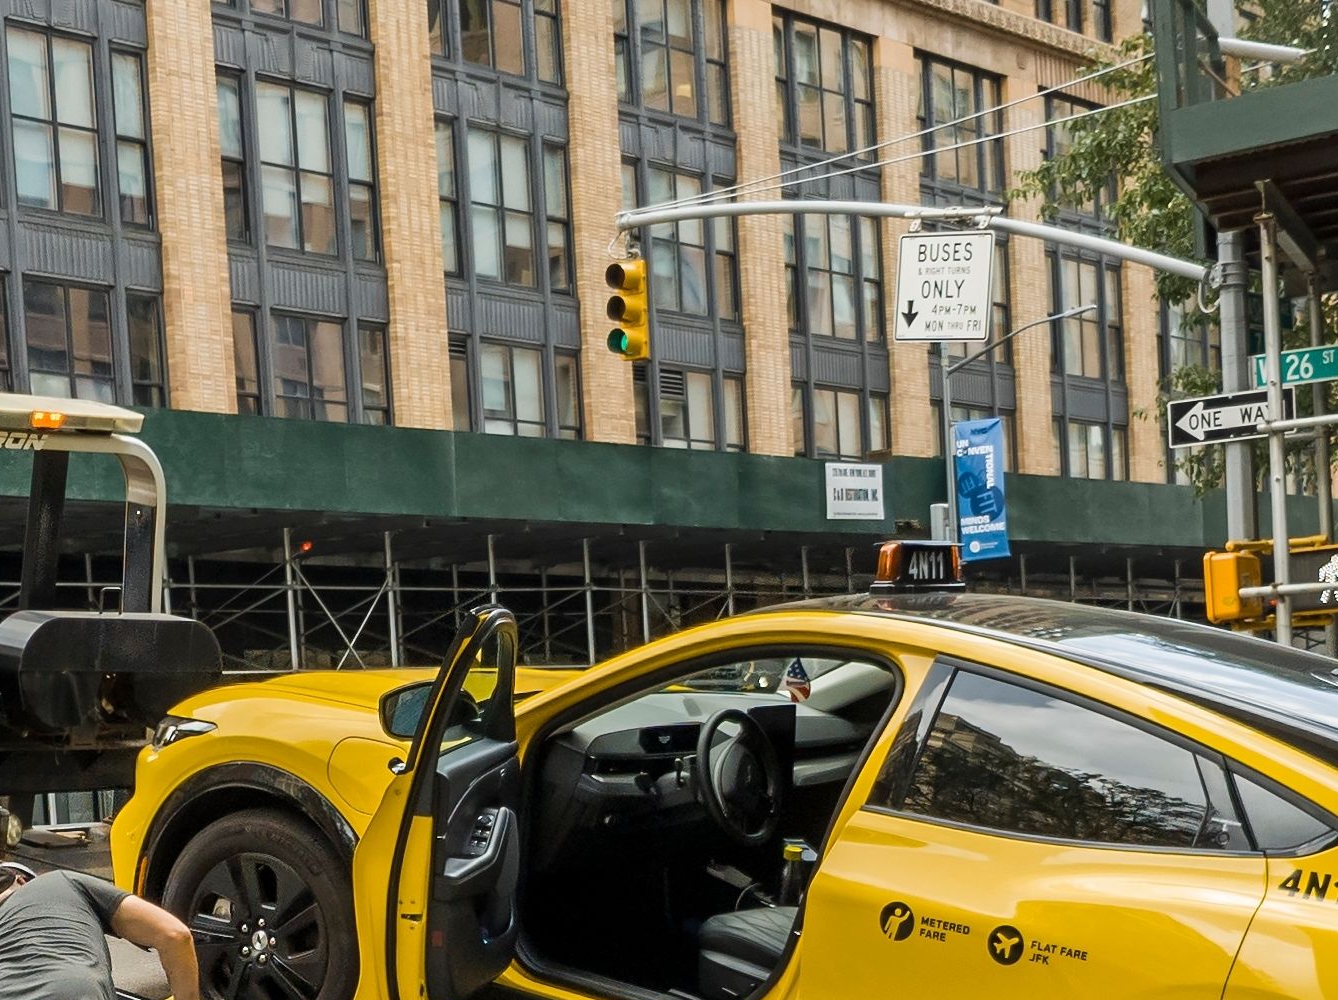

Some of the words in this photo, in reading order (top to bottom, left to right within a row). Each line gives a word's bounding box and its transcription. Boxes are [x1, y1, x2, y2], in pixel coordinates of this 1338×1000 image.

[918, 242, 973, 262] BUSES
[925, 267, 945, 275] RIGHT
[947, 266, 971, 274] TURNS
[921, 279, 965, 299] ONLY
[925, 320, 943, 332] MON
[947, 321, 964, 330] THRU
[966, 319, 982, 332] FRI
[1286, 353, 1314, 381] 26
[1322, 350, 1335, 364] ST
[1188, 411, 1222, 430] ONE
[1240, 402, 1269, 424] WA
[956, 440, 969, 448] UN
[961, 522, 1005, 535] WELCOME
[908, 551, 945, 580] 4N11
[919, 928, 946, 942] FARE
[920, 916, 970, 935] METERED
[1028, 953, 1050, 966] JFK
[1030, 940, 1057, 954] FLAT
[1060, 946, 1088, 961] FARE
